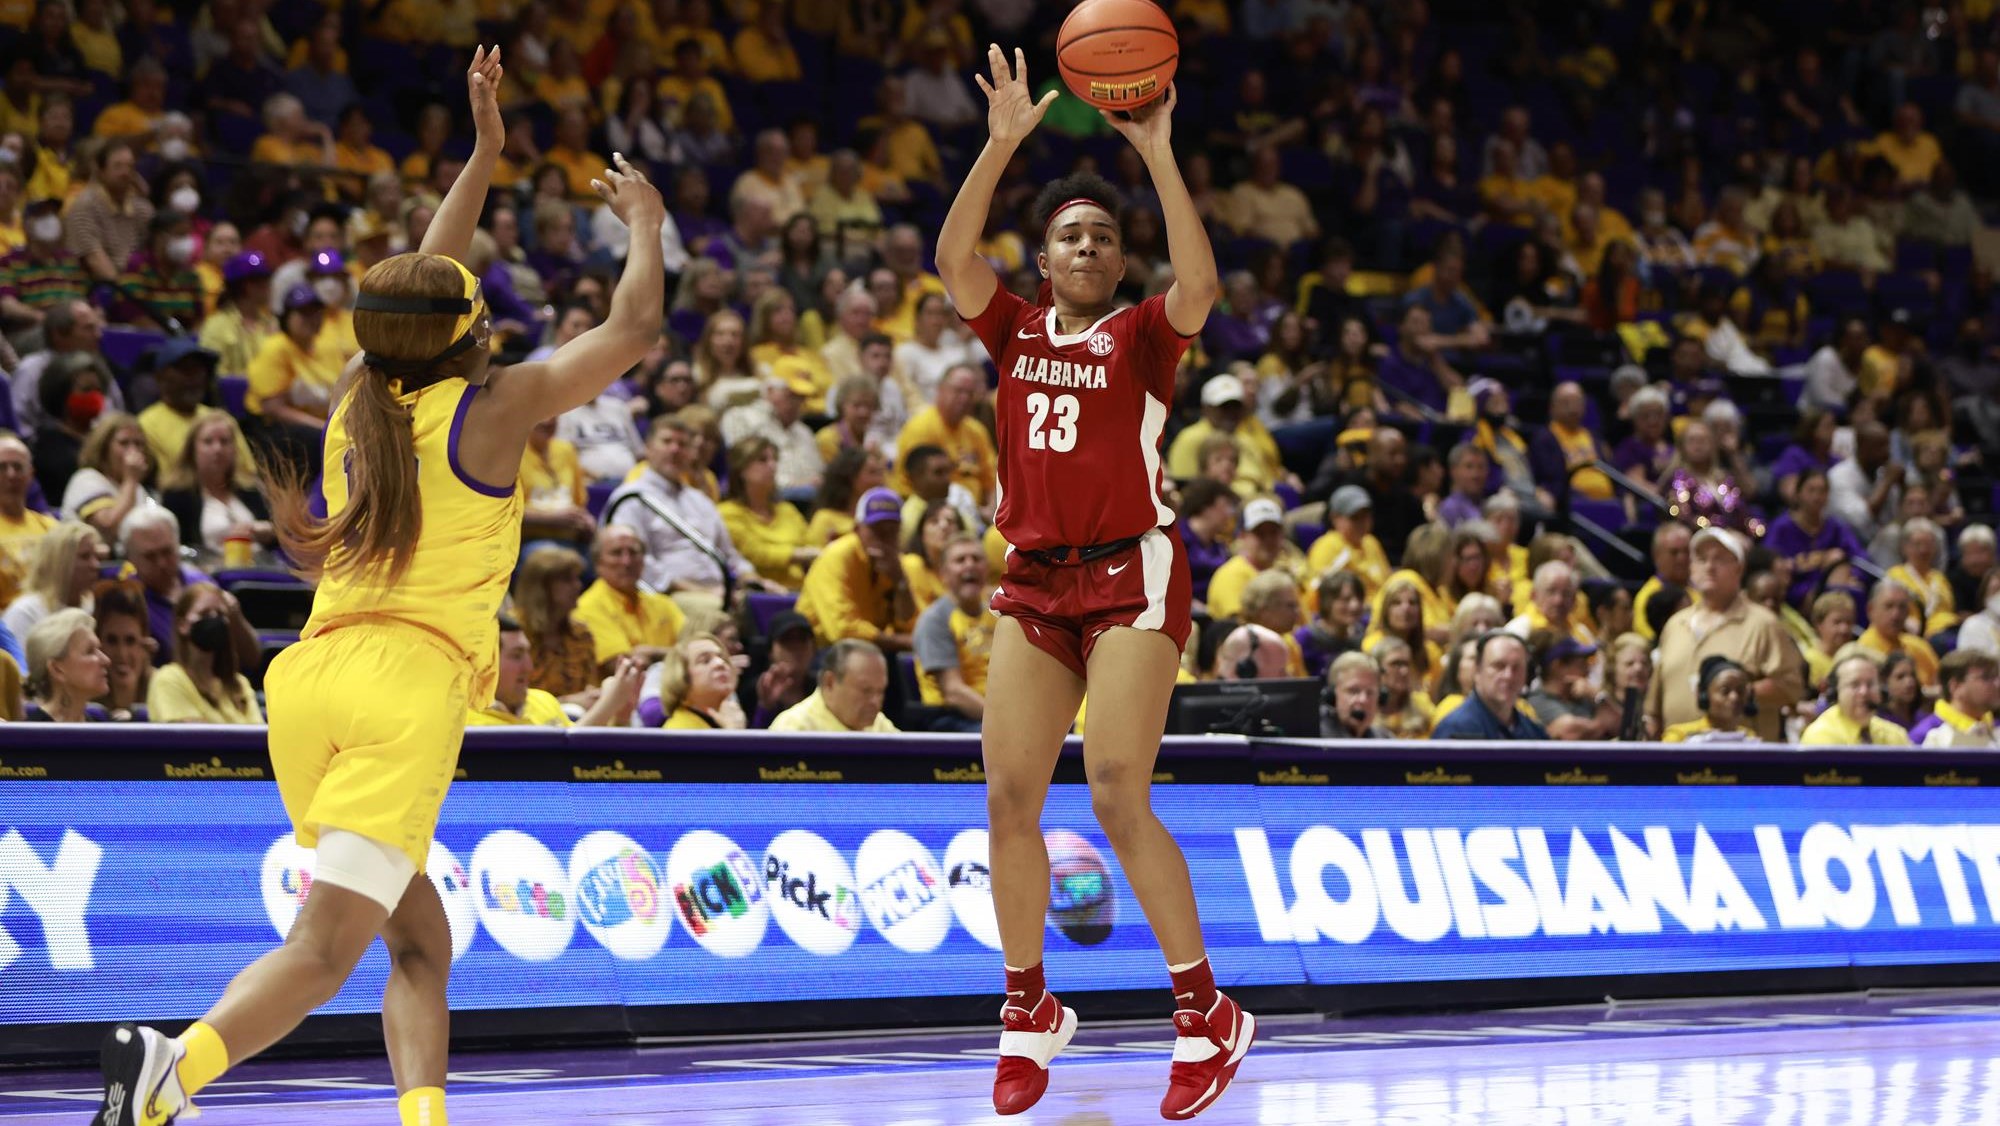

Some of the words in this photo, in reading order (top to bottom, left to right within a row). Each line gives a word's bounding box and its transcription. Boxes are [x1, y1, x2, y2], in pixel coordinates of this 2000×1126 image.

[1089, 333, 1113, 355] SEC
[1012, 355, 1108, 389] ALABAMA
[1026, 392, 1080, 453] 23
[164, 757, 263, 777] RoofClaim.com
[767, 854, 832, 921] Pick
[1234, 823, 1768, 944] LOUISIANA
